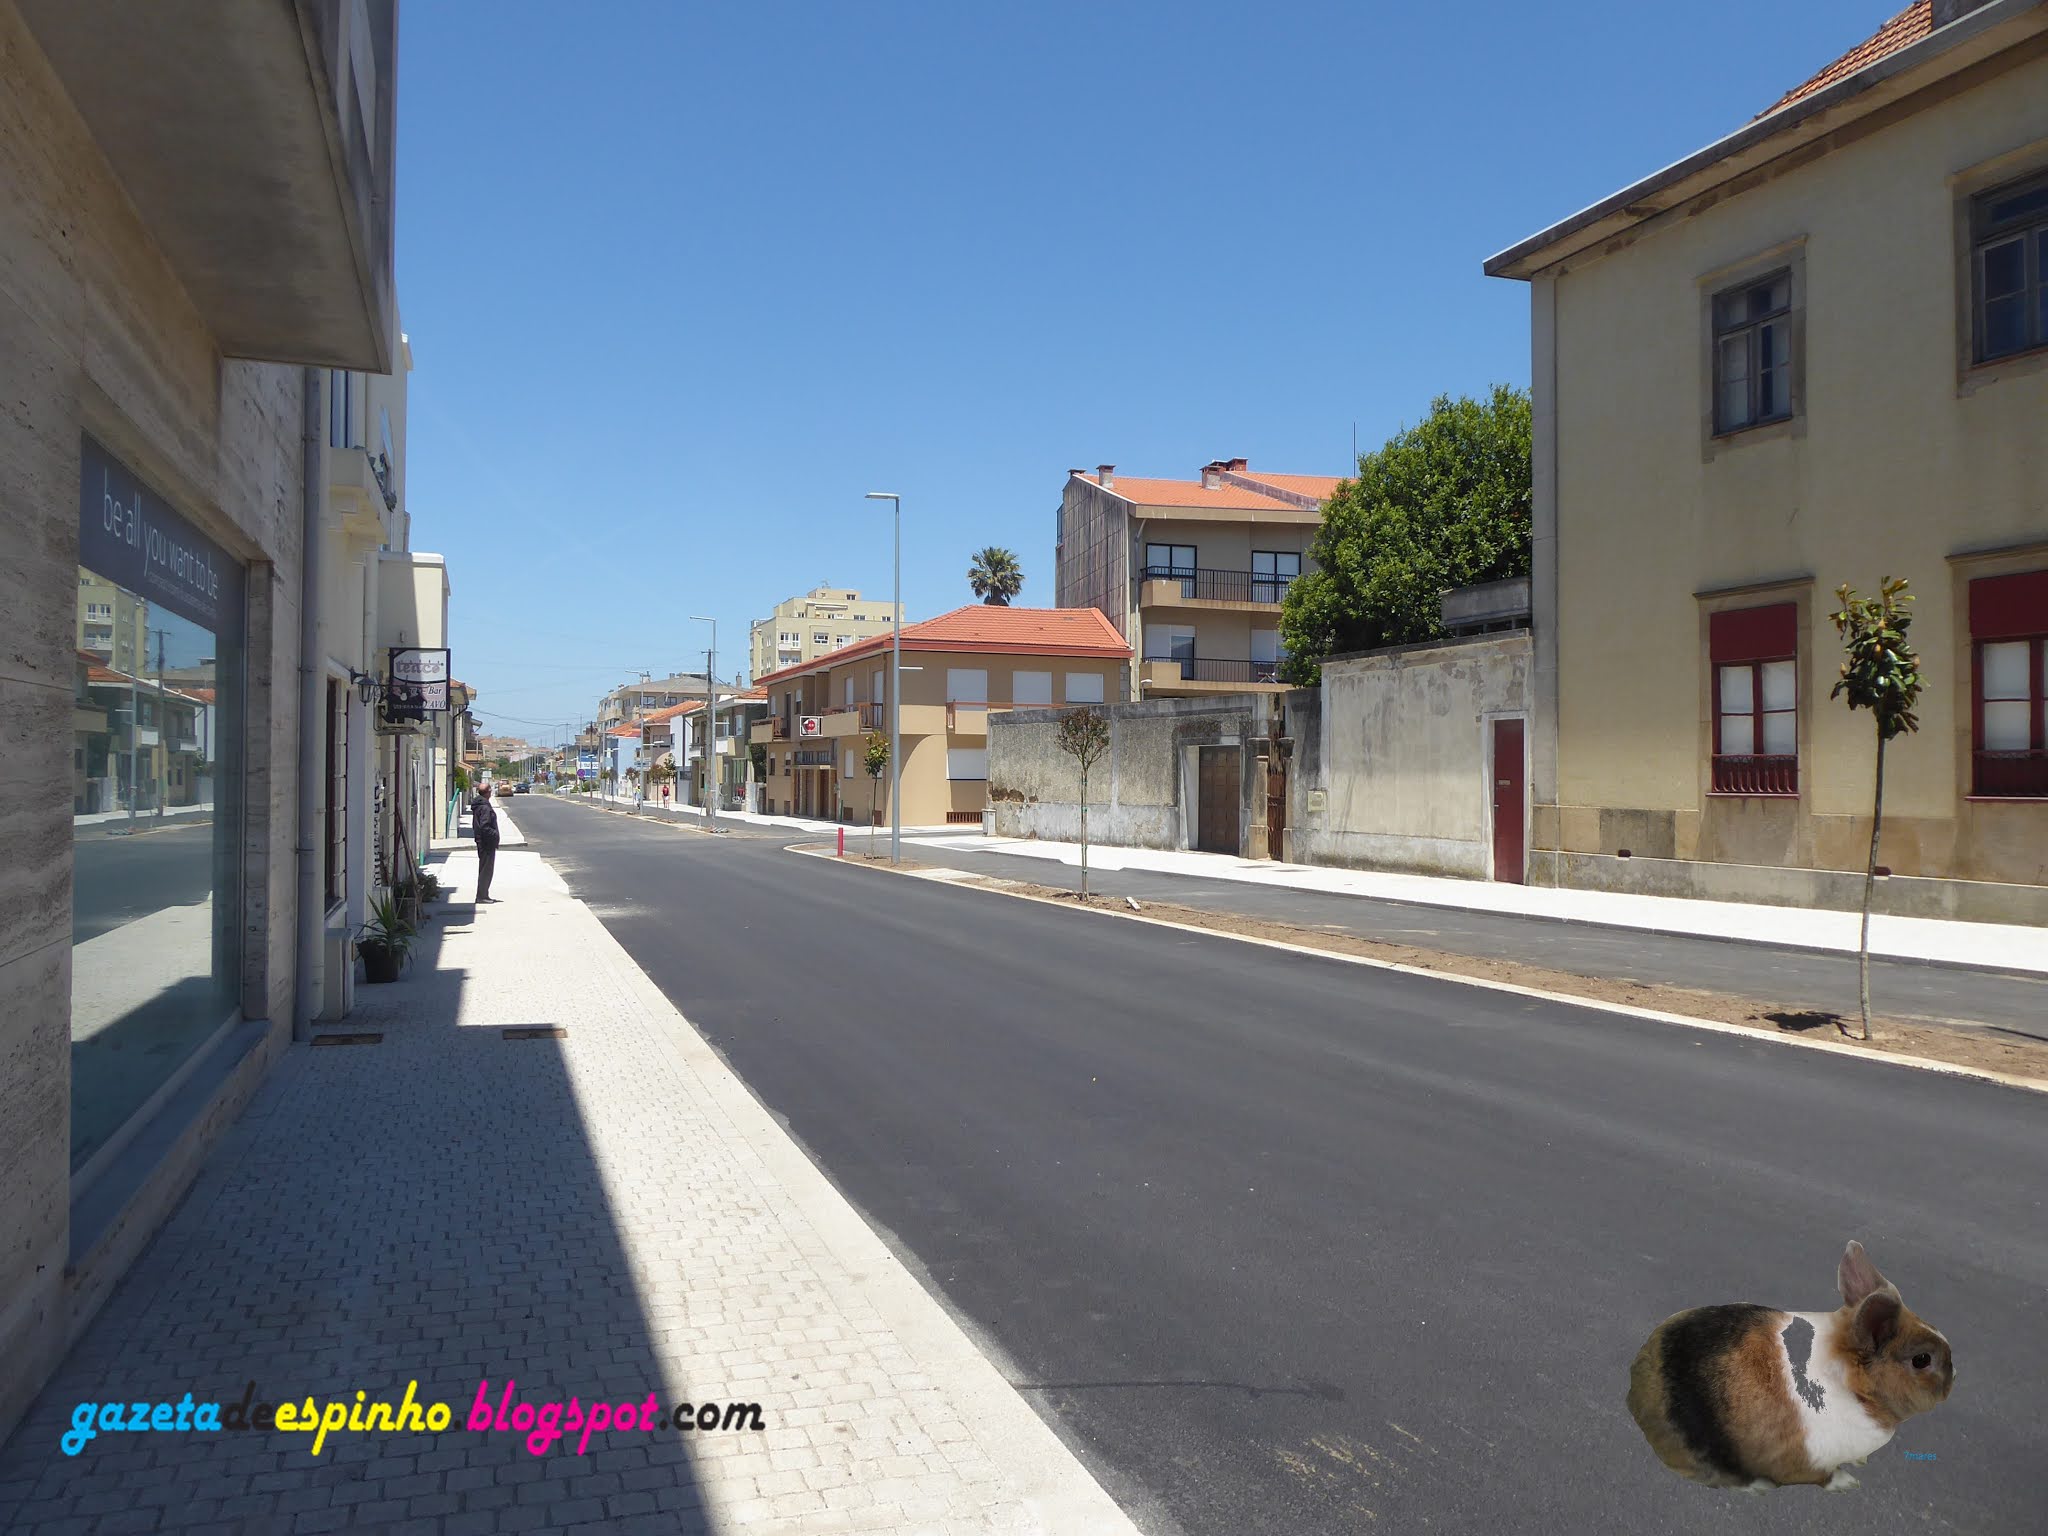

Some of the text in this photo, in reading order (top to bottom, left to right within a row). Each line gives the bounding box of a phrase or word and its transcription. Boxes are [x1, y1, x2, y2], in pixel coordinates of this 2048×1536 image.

[103, 467, 122, 537] be
[126, 492, 141, 549] all
[143, 520, 166, 577] you
[169, 540, 194, 585] want
[196, 554, 206, 592] to
[207, 552, 218, 601] be
[428, 686, 442, 695] Bar
